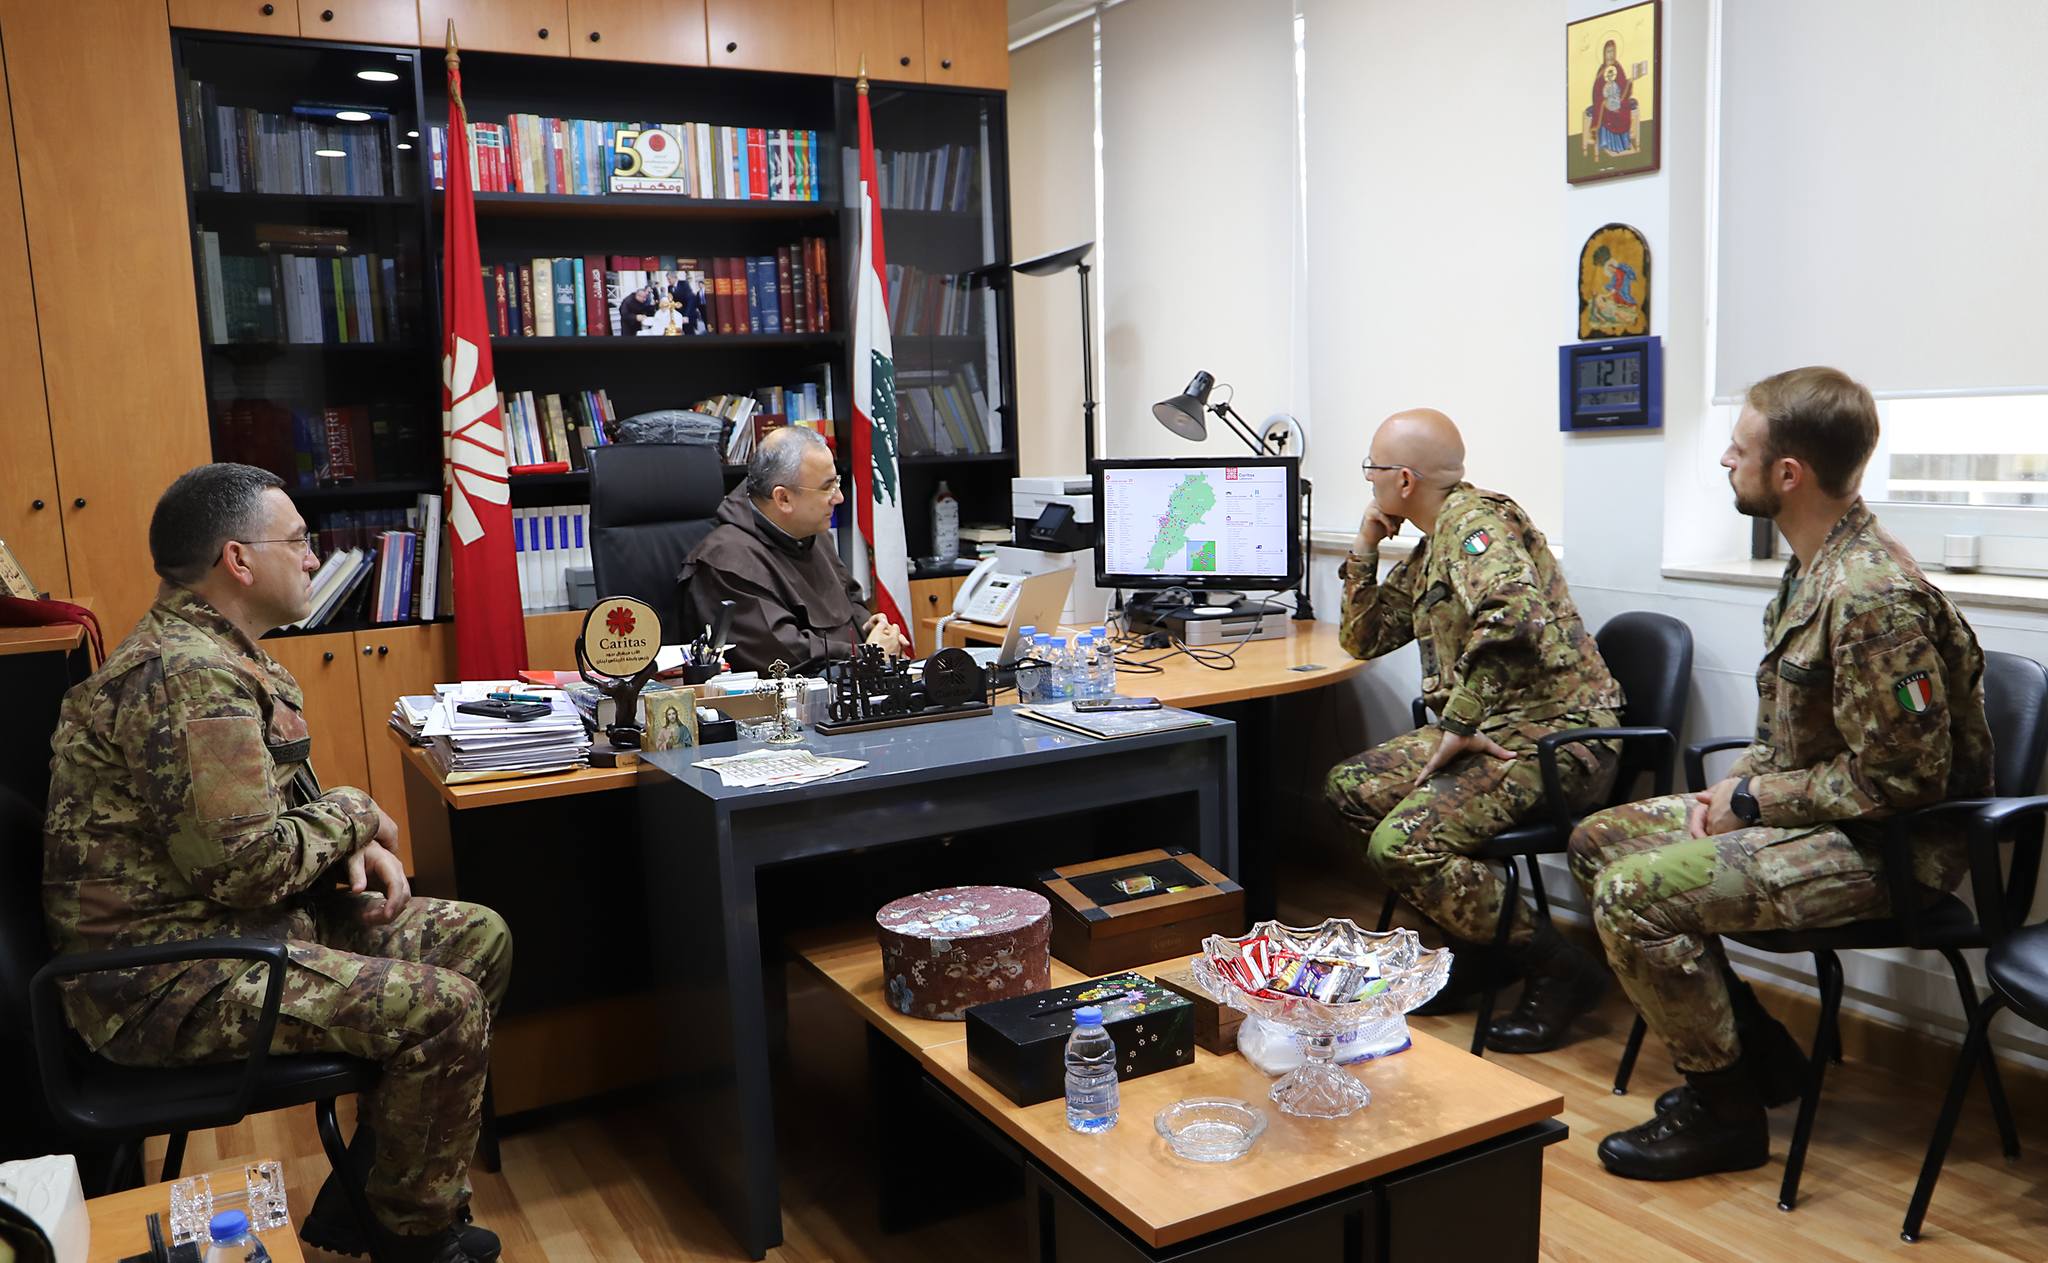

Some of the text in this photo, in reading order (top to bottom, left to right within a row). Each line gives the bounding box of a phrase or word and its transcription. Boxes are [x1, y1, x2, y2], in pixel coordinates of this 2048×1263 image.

[614, 129, 682, 178] 50
[599, 637, 647, 650] Caritas
[1897, 673, 1925, 689] ITALIA
